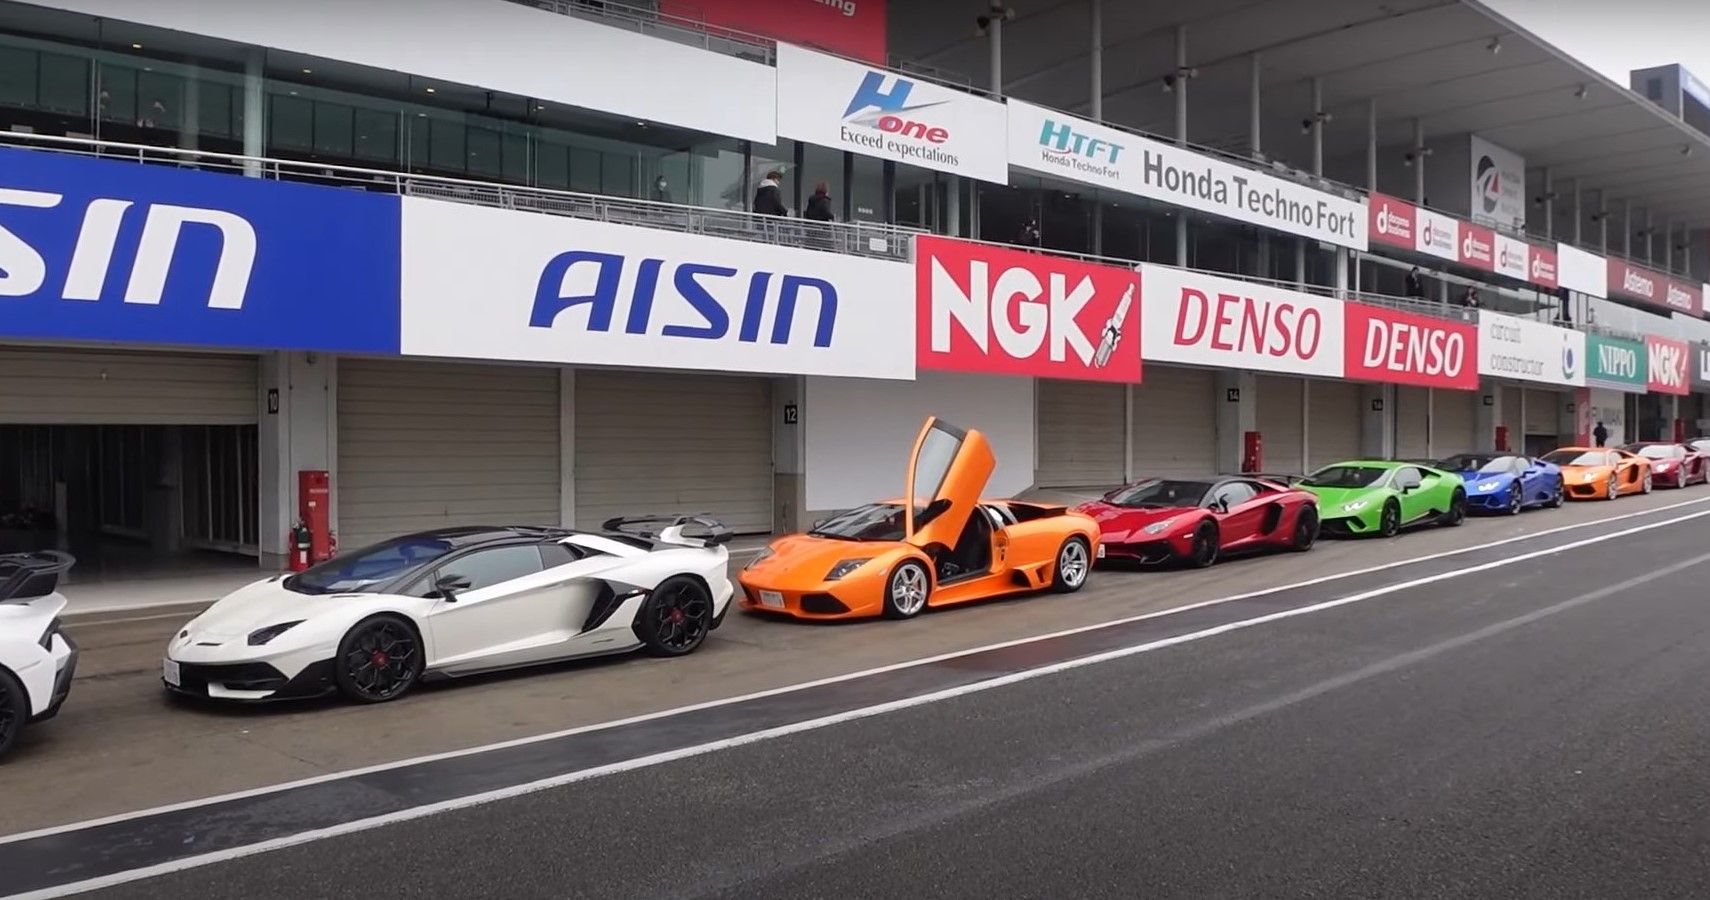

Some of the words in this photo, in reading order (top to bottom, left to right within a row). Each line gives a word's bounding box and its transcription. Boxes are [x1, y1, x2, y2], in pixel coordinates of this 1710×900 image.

[840, 126, 884, 149] Exceed
[887, 139, 959, 166] expectations
[878, 115, 949, 144] one
[1039, 119, 1125, 164] HTFT
[1042, 151, 1071, 167] Honda
[1144, 150, 1228, 204] Honda
[530, 250, 838, 348] AISIN
[931, 254, 1096, 368] NGK
[1173, 287, 1322, 361] DENSO
[1363, 318, 1464, 378] DENSO
[1598, 343, 1636, 378] NIPPO
[1647, 342, 1680, 388] NGK
[786, 407, 796, 421] 12
